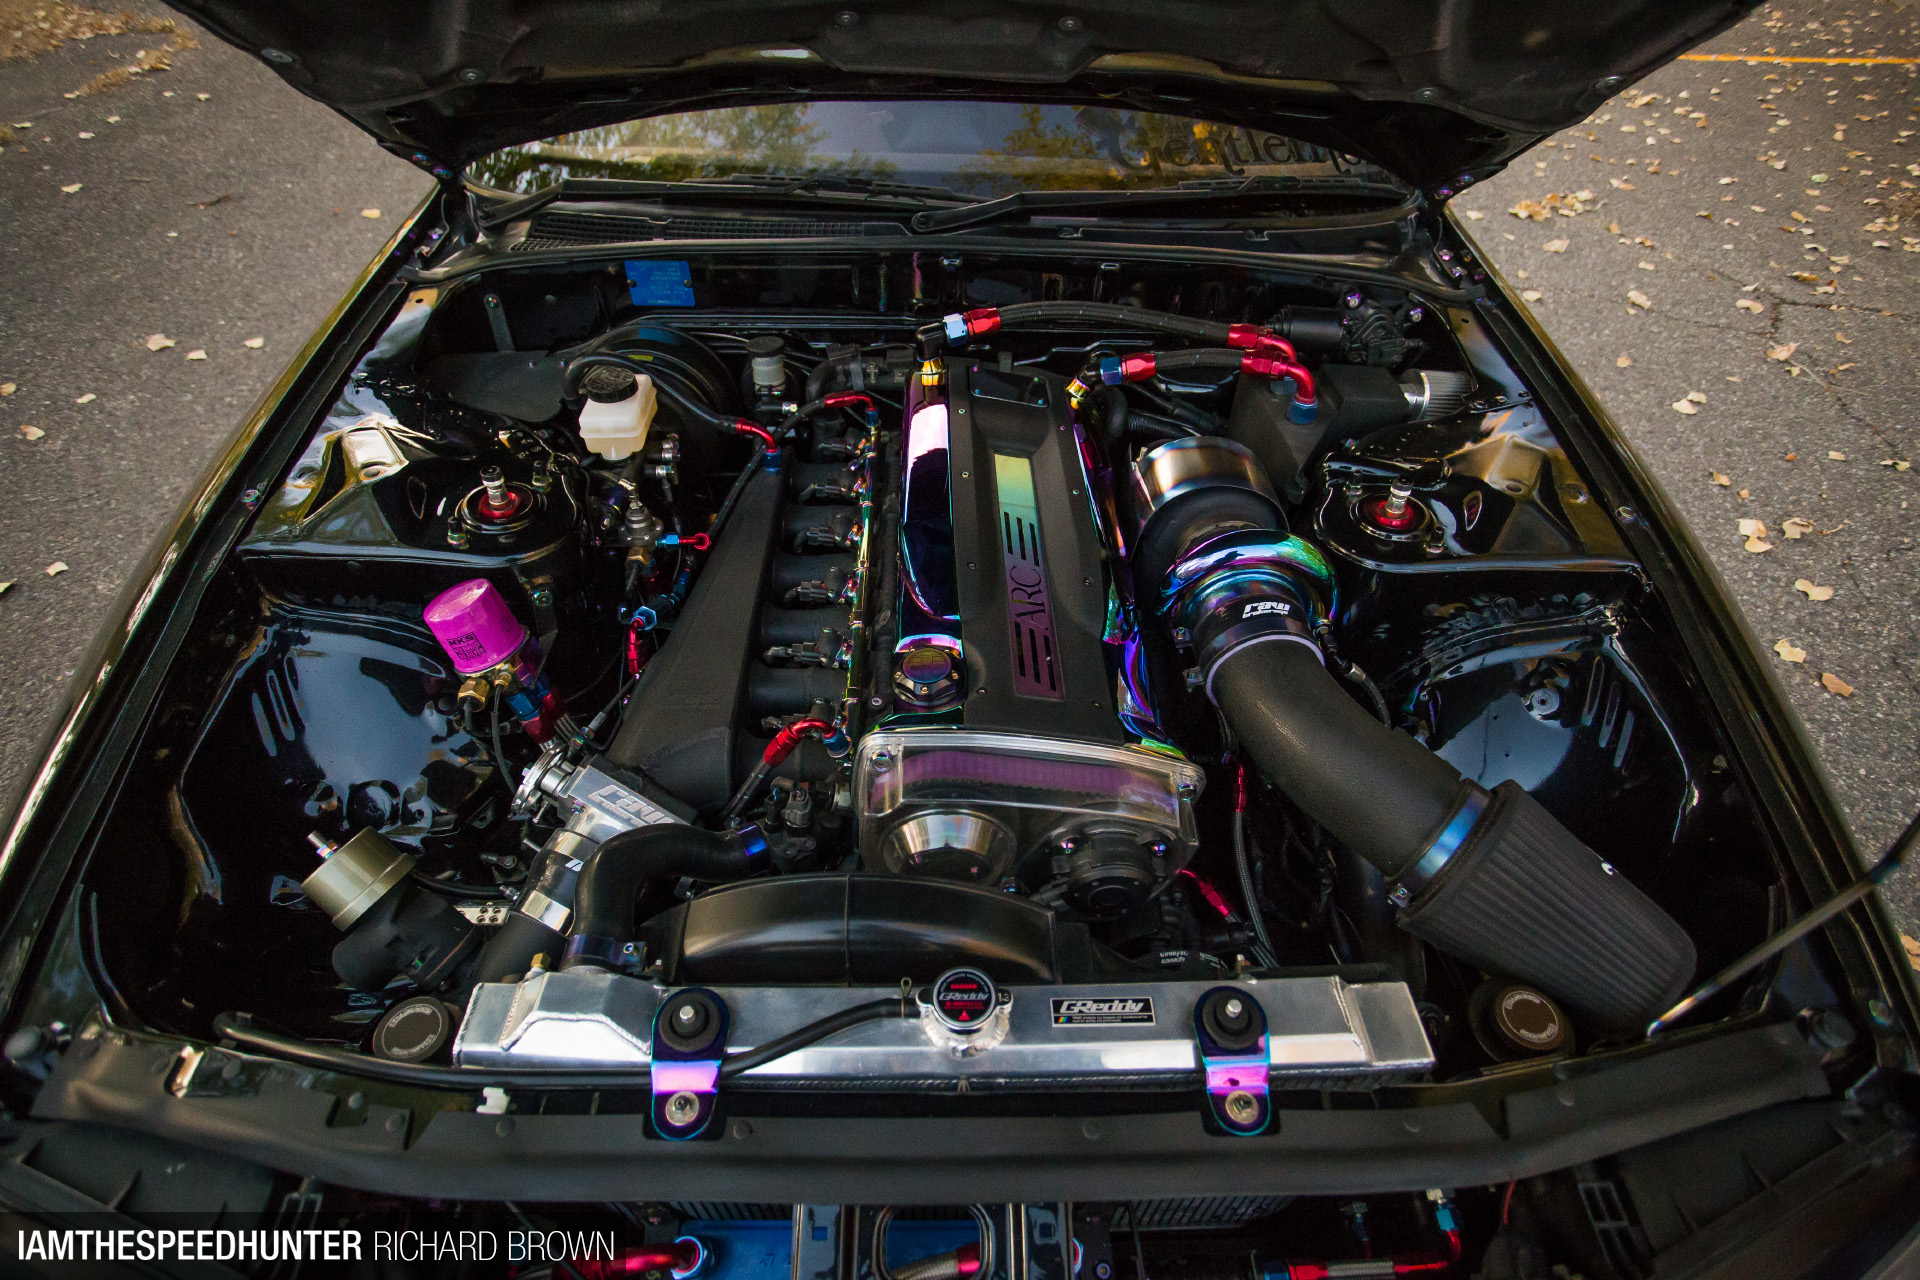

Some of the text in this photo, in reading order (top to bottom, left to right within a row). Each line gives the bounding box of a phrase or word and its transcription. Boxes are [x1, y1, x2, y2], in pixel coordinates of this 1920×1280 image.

[1010, 565, 1049, 632] ARC
[1244, 601, 1291, 613] raw
[448, 633, 476, 646] HKS
[938, 992, 990, 1001] GReddy
[1060, 999, 1145, 1014] GReddy
